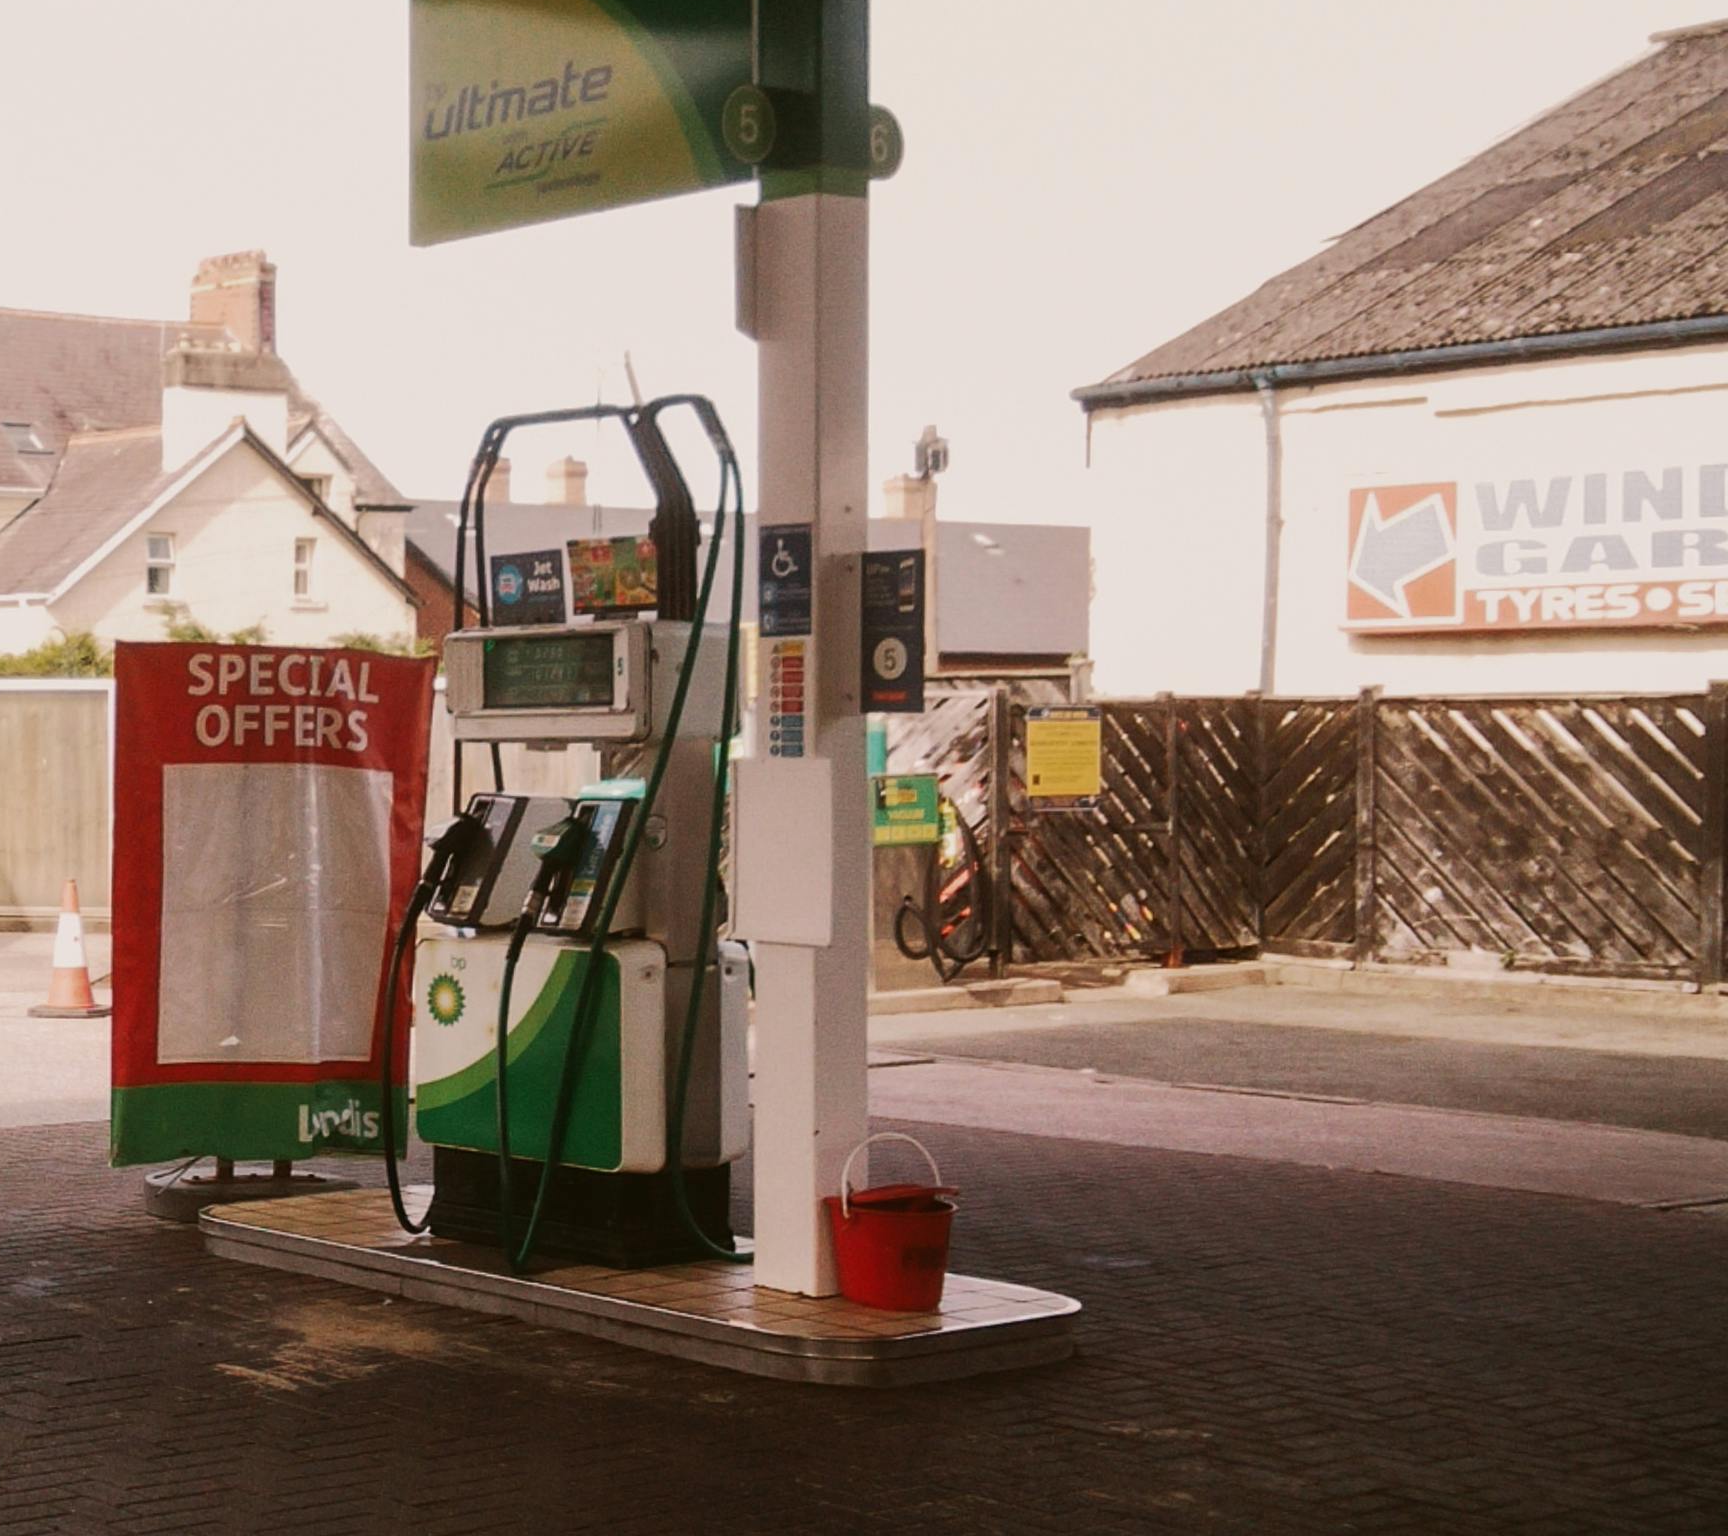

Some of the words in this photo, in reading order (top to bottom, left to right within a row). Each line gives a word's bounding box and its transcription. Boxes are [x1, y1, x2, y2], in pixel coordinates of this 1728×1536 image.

[424, 60, 613, 140] ultimate
[741, 105, 758, 143] 5
[872, 124, 887, 161] 6
[496, 130, 598, 174] ACTIVE
[528, 576, 560, 593] Wash
[533, 561, 553, 576] Jet
[1475, 584, 1641, 624] TYRES
[187, 653, 379, 704] SPECIAL
[884, 648, 896, 671] 5
[195, 704, 369, 752] OFFERS
